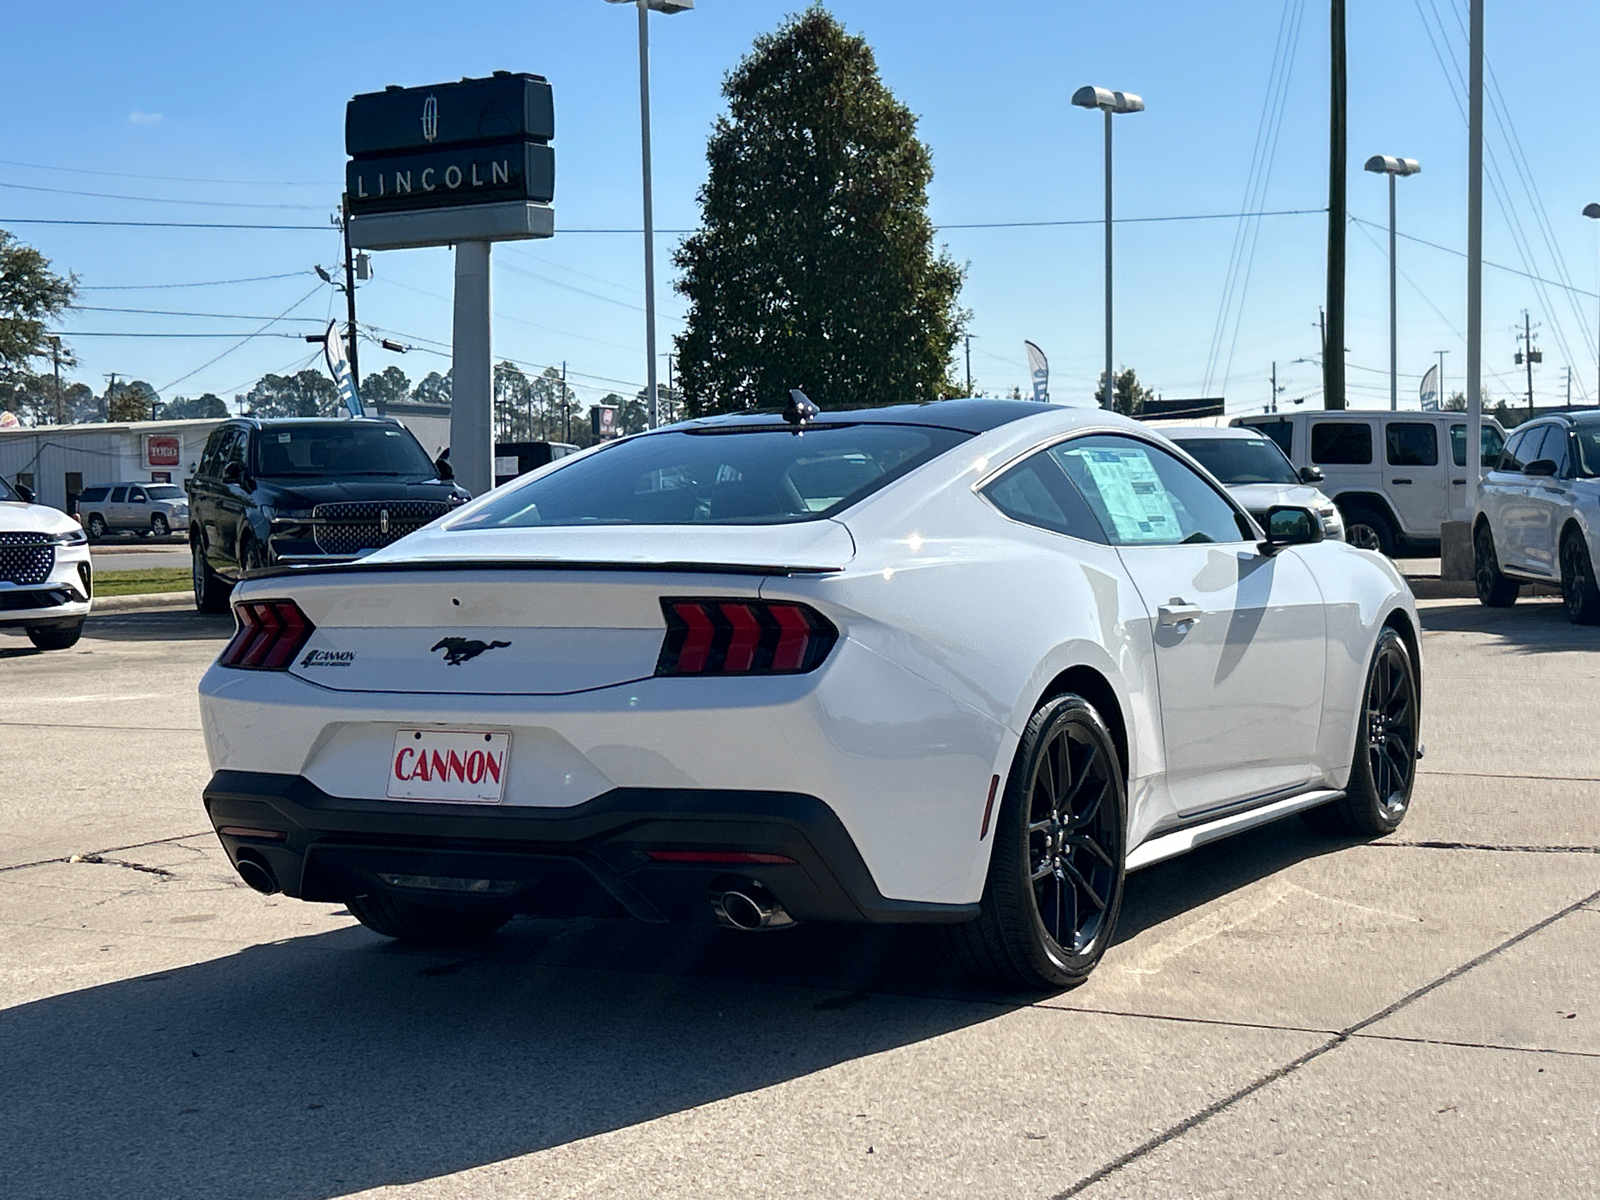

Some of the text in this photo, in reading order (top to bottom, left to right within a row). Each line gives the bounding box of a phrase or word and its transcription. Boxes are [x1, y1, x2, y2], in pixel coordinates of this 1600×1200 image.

[357, 159, 509, 198] LINCOLN
[150, 446, 178, 457] TORO
[315, 650, 357, 661] CANNON
[394, 747, 504, 784] CANNON
